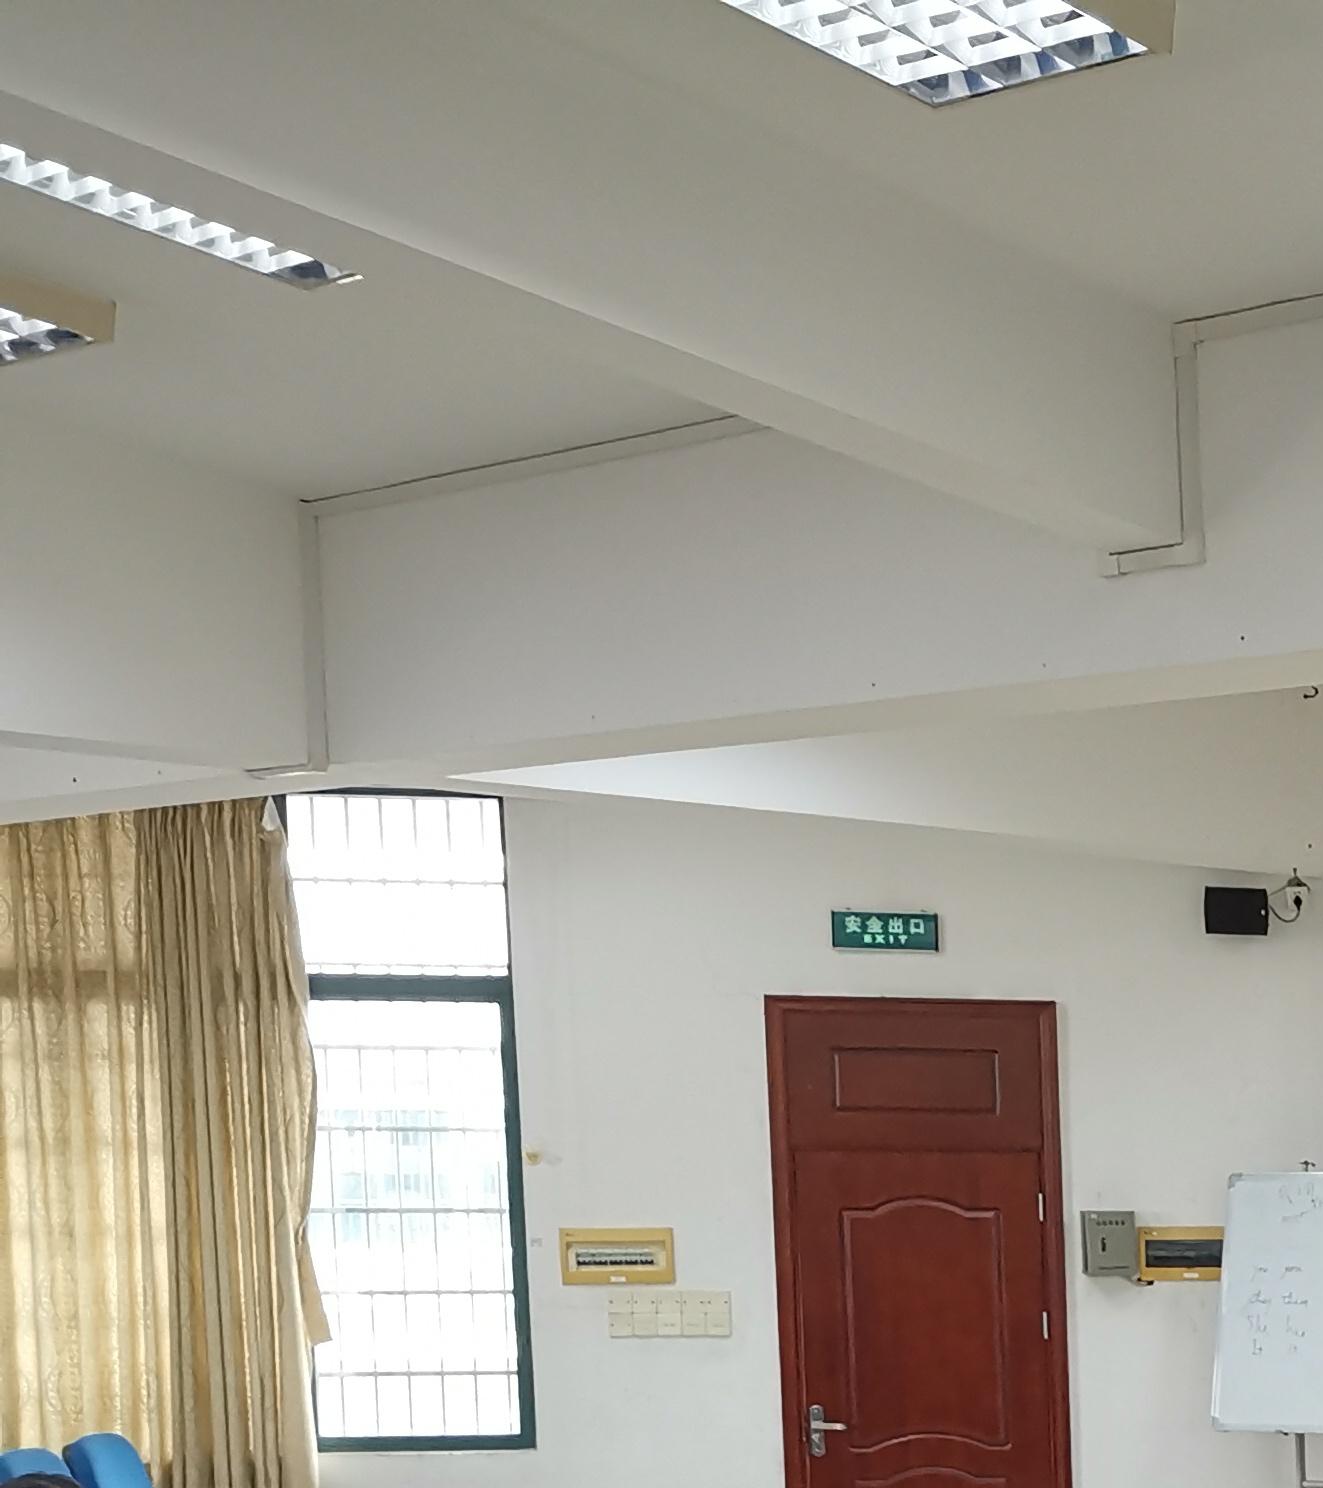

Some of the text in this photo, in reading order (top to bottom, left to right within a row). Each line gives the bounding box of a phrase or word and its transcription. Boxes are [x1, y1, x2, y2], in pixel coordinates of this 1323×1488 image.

[844, 915, 925, 934] 安全出口
[863, 934, 908, 945] EXIT
